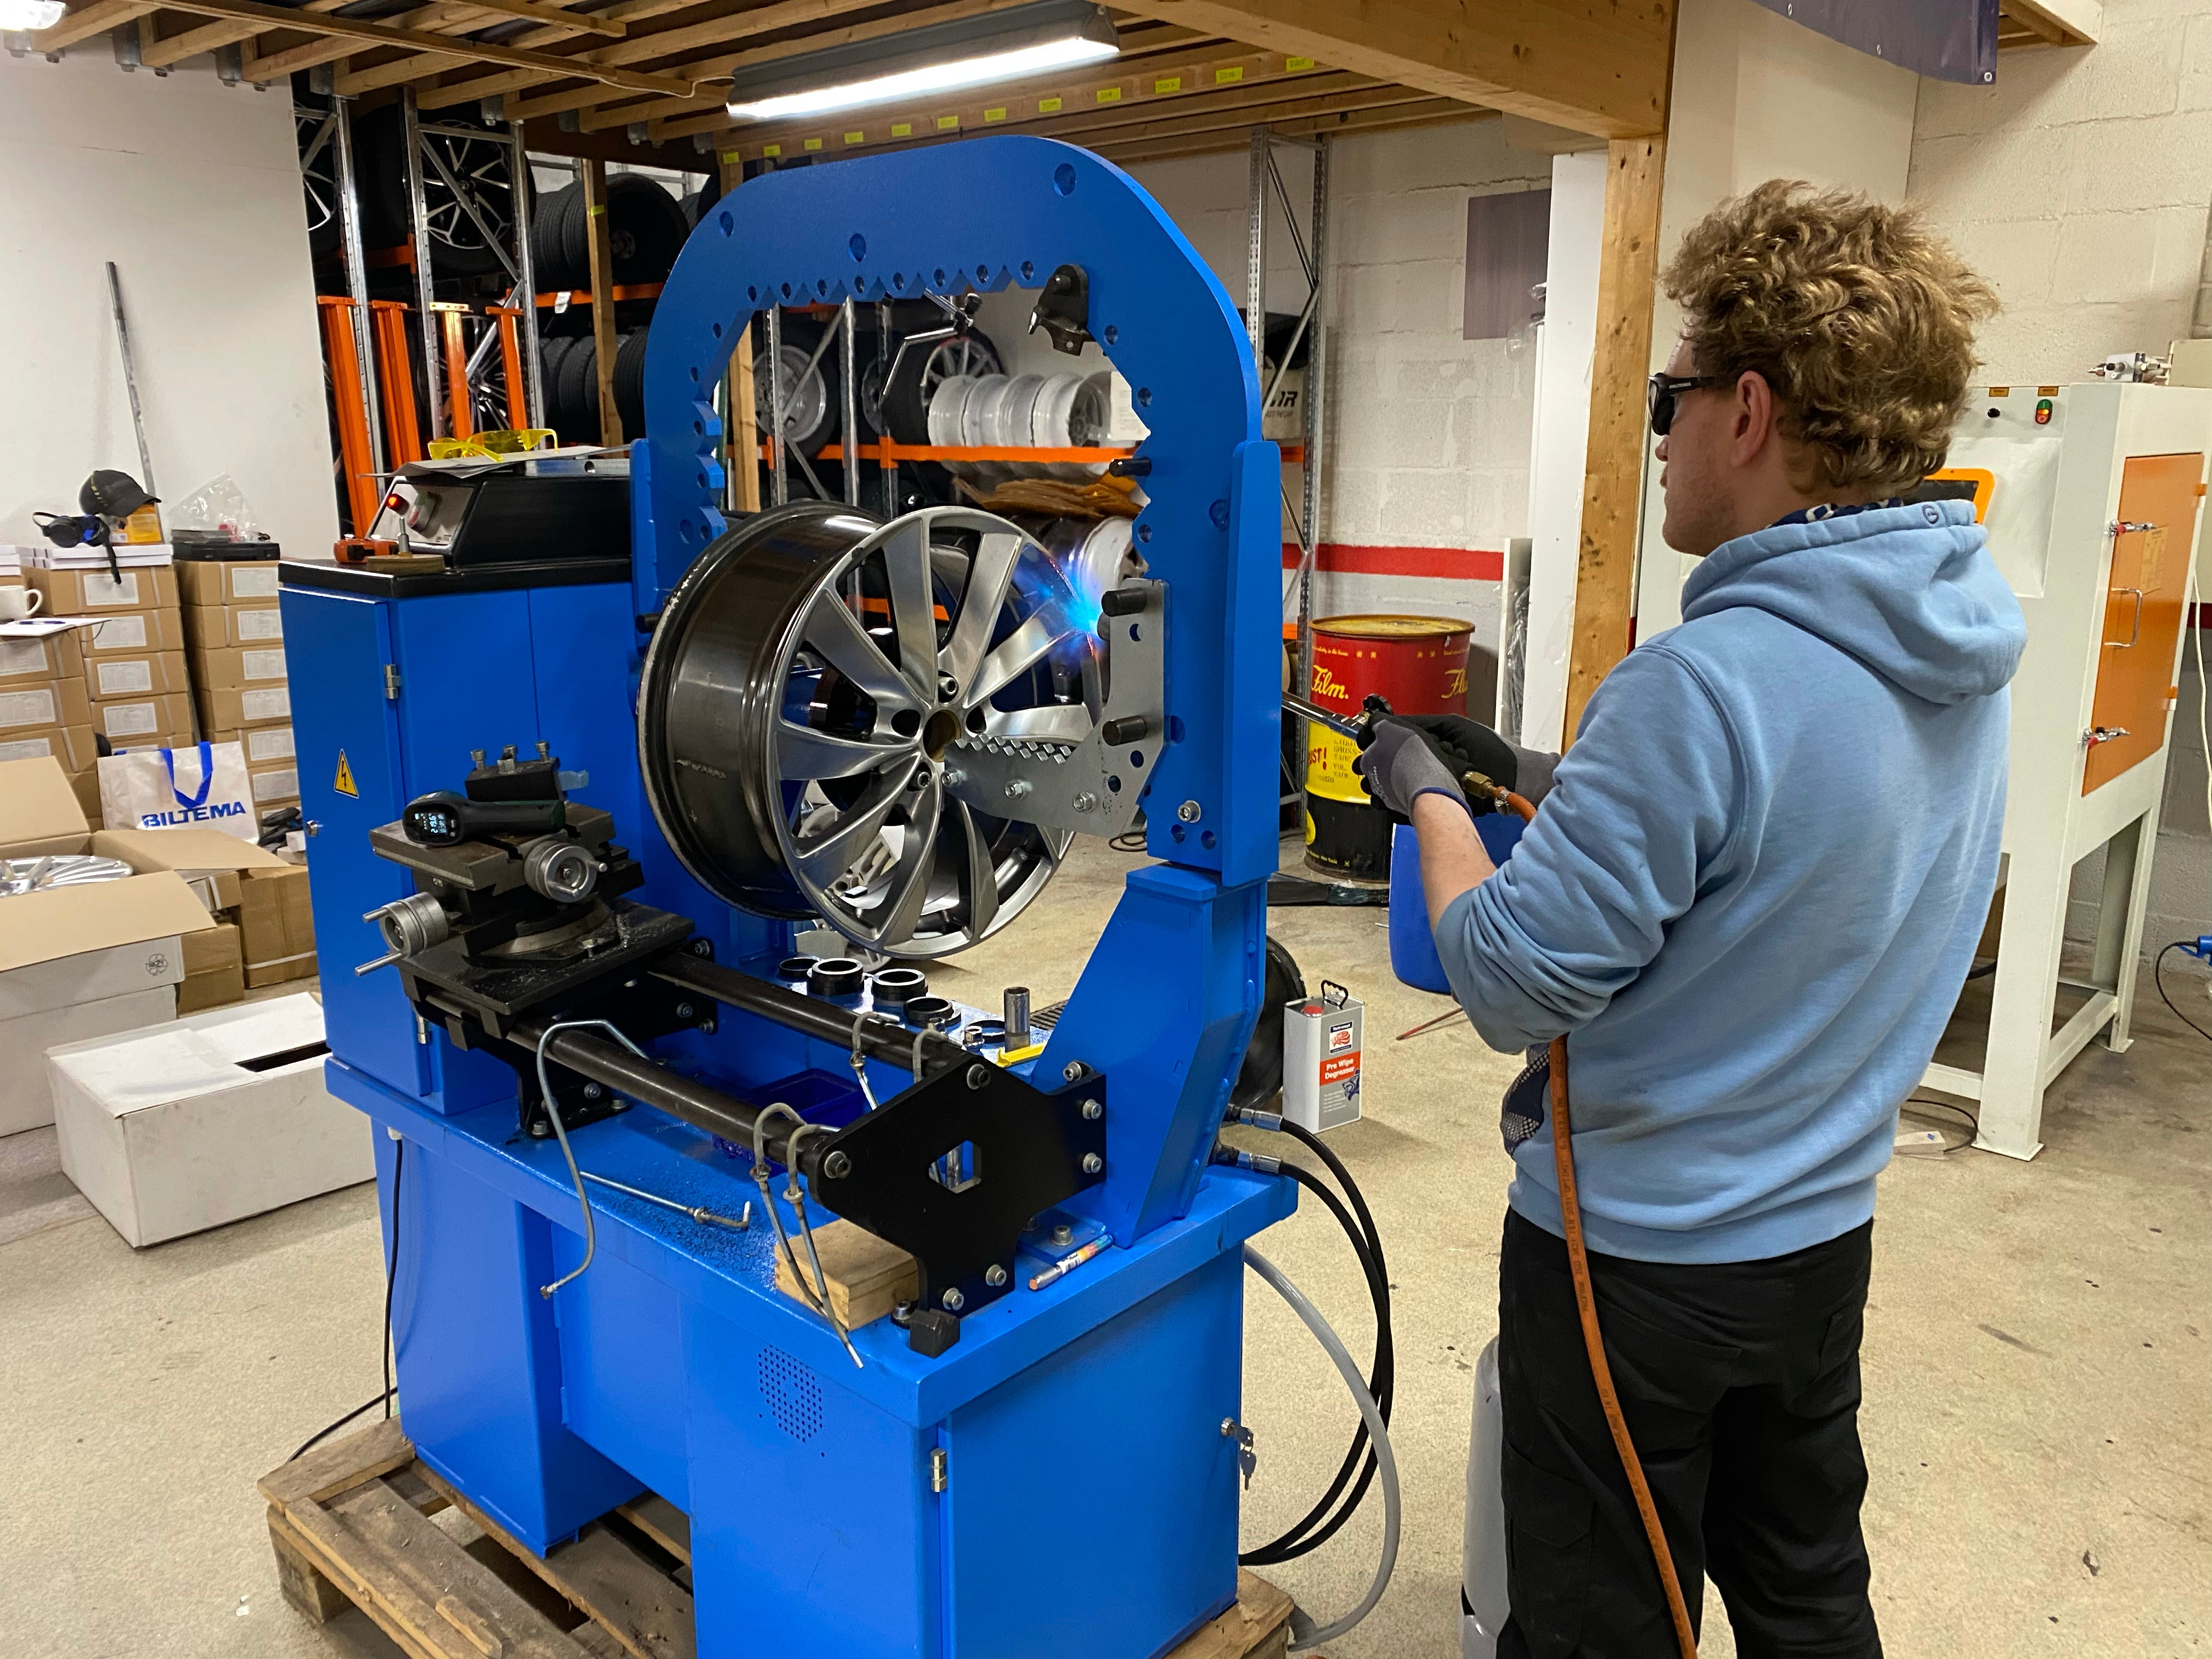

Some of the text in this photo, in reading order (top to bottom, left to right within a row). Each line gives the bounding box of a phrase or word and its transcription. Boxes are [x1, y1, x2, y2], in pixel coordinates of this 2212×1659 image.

[142, 802, 246, 828] BILTEMA
[1326, 1058, 1354, 1071] Pre Wipe
[1325, 1066, 1356, 1080] Degreaser
